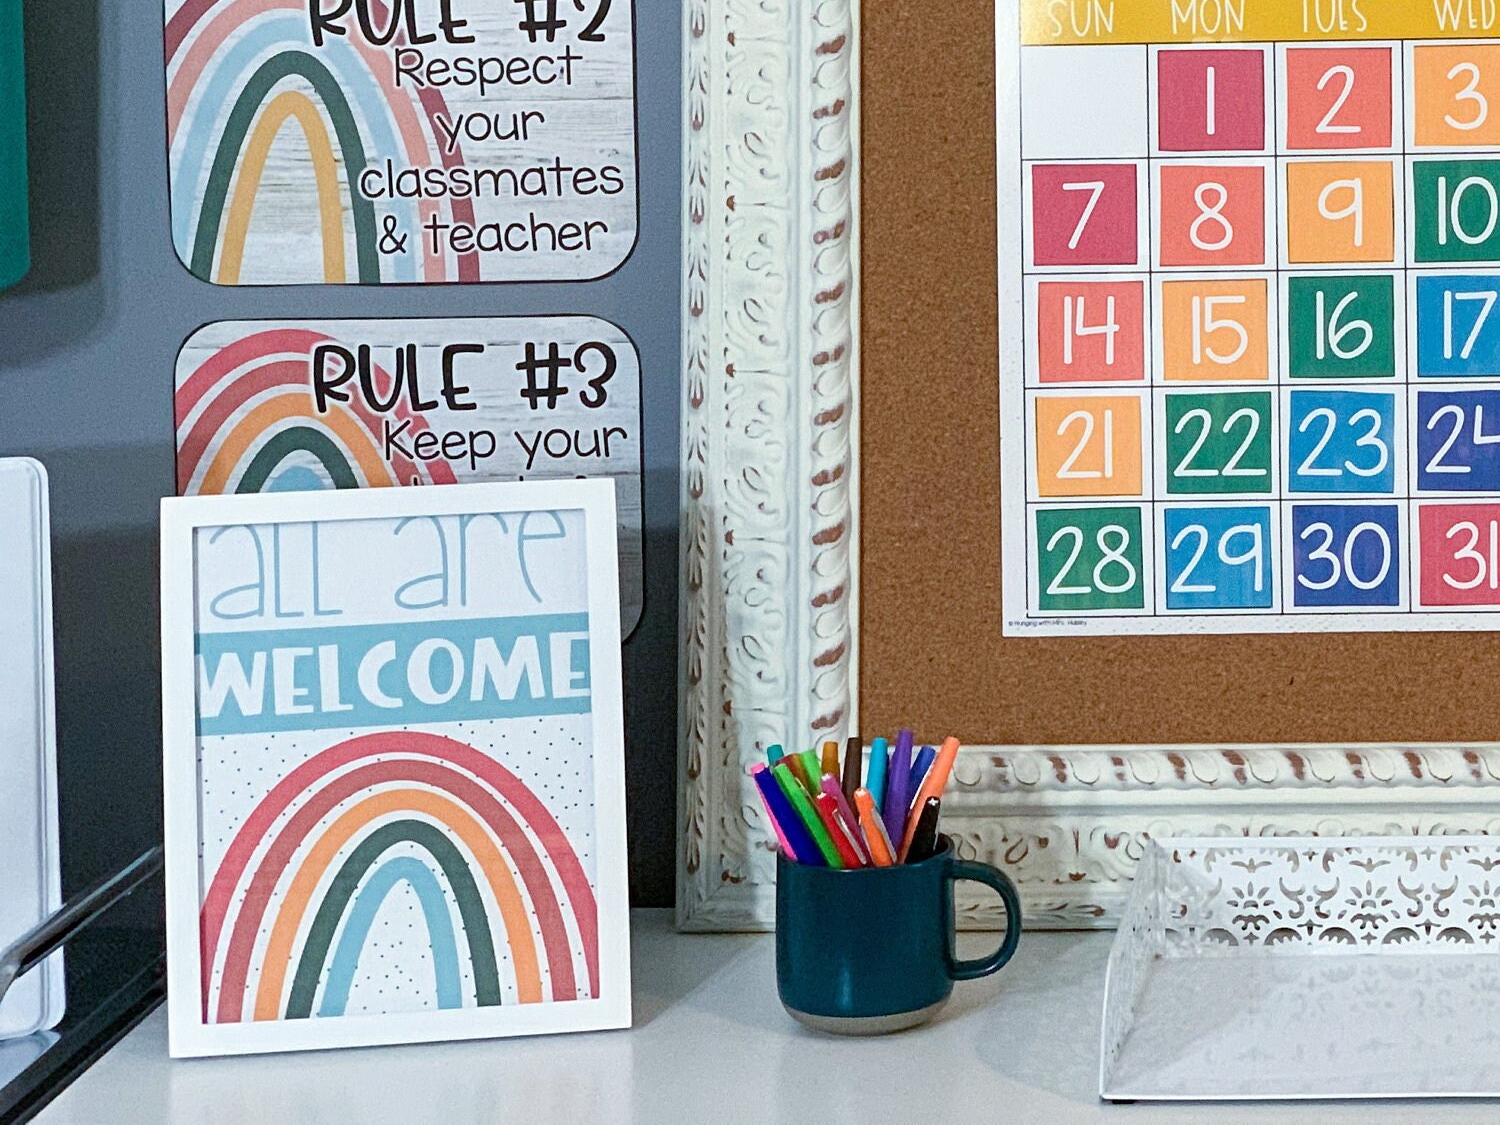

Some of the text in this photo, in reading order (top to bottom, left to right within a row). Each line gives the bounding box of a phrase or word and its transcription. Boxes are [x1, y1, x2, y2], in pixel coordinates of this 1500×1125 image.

[395, 45, 583, 96] Respect
[1206, 66, 1215, 135] 1
[1315, 64, 1362, 134] 2
[1444, 61, 1488, 130] 3
[437, 110, 545, 152] your
[360, 158, 624, 200] classmates
[1062, 180, 1105, 249] 7
[1190, 182, 1234, 251] 8
[1317, 177, 1363, 247] 9
[1437, 176, 1498, 245] 10
[378, 212, 607, 254] & teacher
[1064, 295, 1120, 365] 14
[1192, 295, 1248, 365] 15
[1315, 290, 1374, 360] 16
[1443, 290, 1498, 361] 17
[313, 342, 618, 414] RULE #3
[384, 420, 628, 471] Keep your
[1056, 409, 1113, 480] 21
[1173, 408, 1267, 477] 22
[1297, 407, 1389, 477] 23
[1046, 519, 1498, 595] 28 29 30 31
[195, 631, 591, 719] WELCOME
